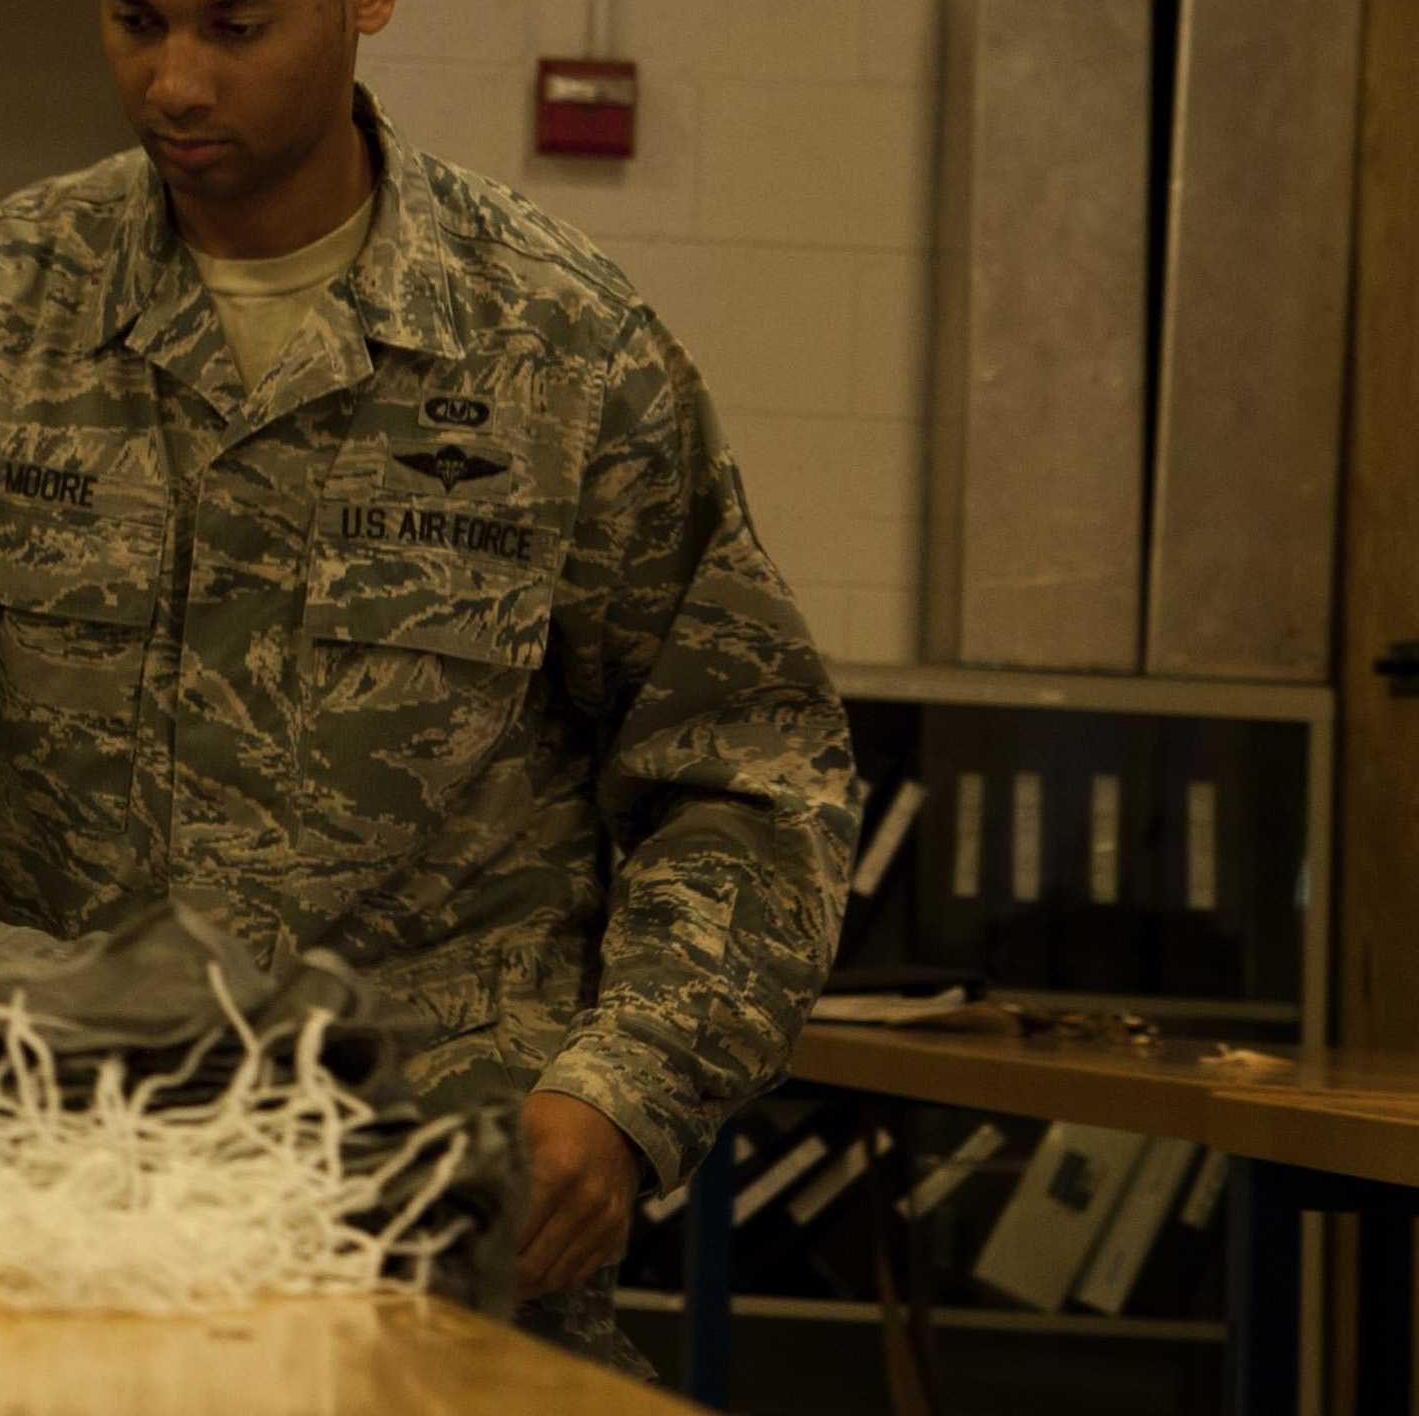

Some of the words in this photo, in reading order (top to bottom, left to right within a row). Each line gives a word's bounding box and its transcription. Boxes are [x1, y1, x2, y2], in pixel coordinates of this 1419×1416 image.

[4, 461, 97, 508] MOORE
[341, 507, 388, 540] U.S.
[398, 510, 447, 543] AIR
[452, 514, 532, 561] FORCE
